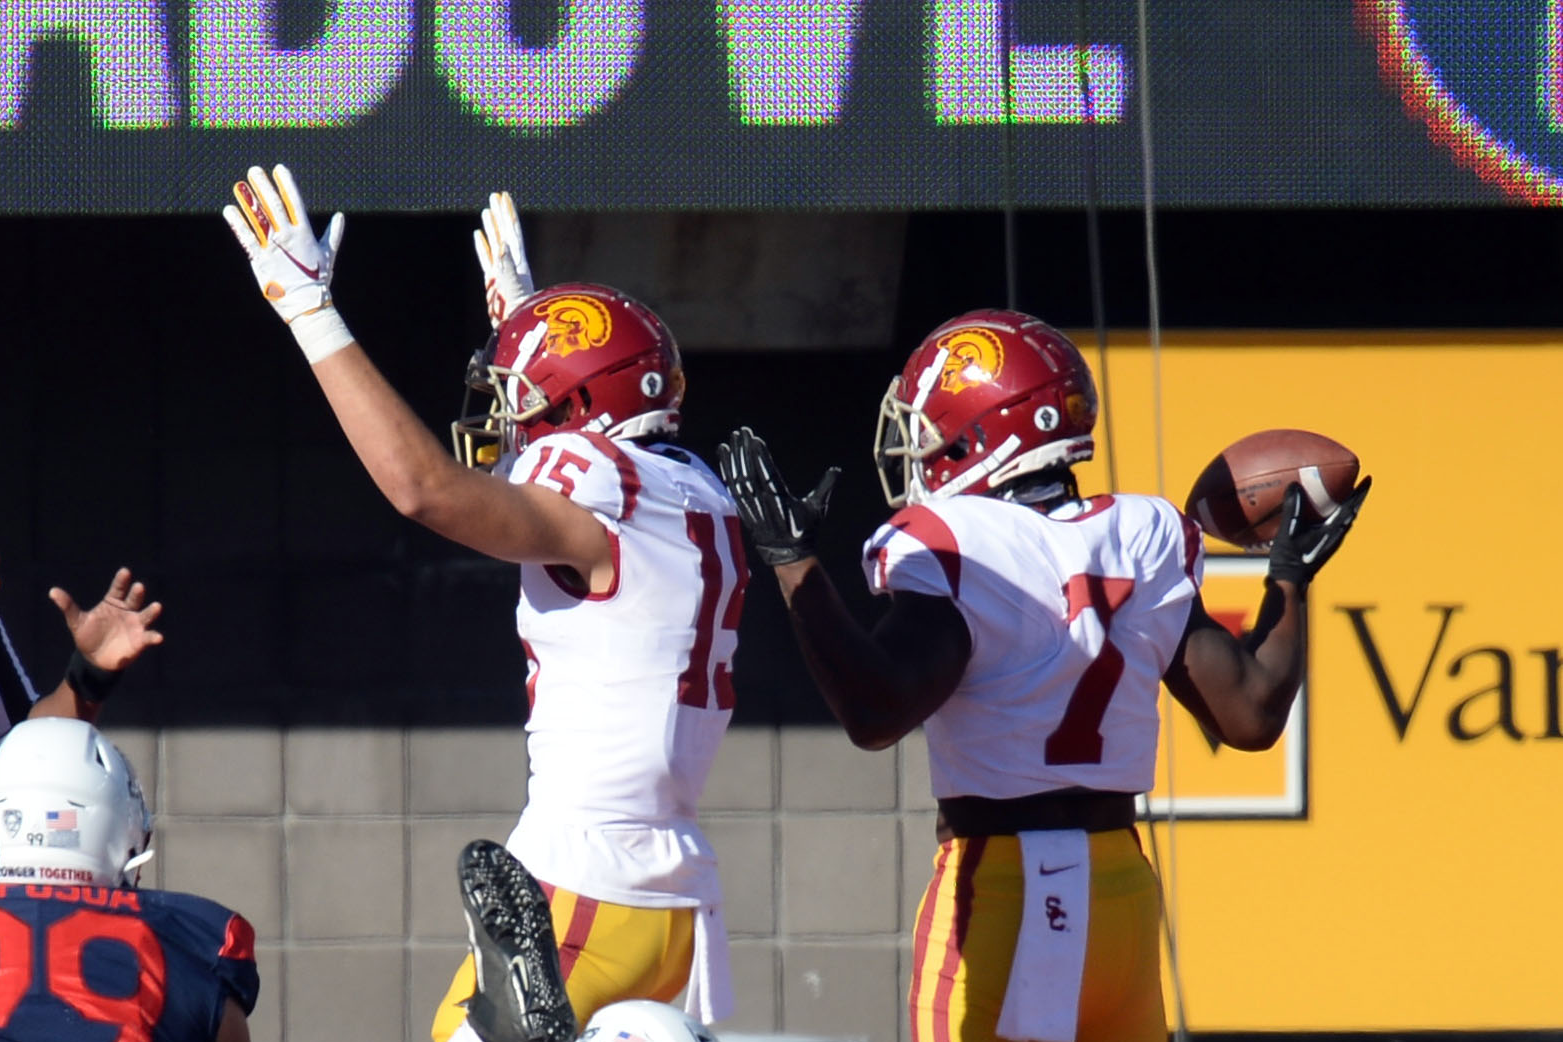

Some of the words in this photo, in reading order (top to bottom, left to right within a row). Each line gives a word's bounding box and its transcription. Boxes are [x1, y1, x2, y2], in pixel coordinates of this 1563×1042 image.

[526, 445, 593, 500] 15
[1042, 572, 1136, 766] 7
[26, 832, 44, 847] 99
[38, 866, 94, 883] TOGETHER
